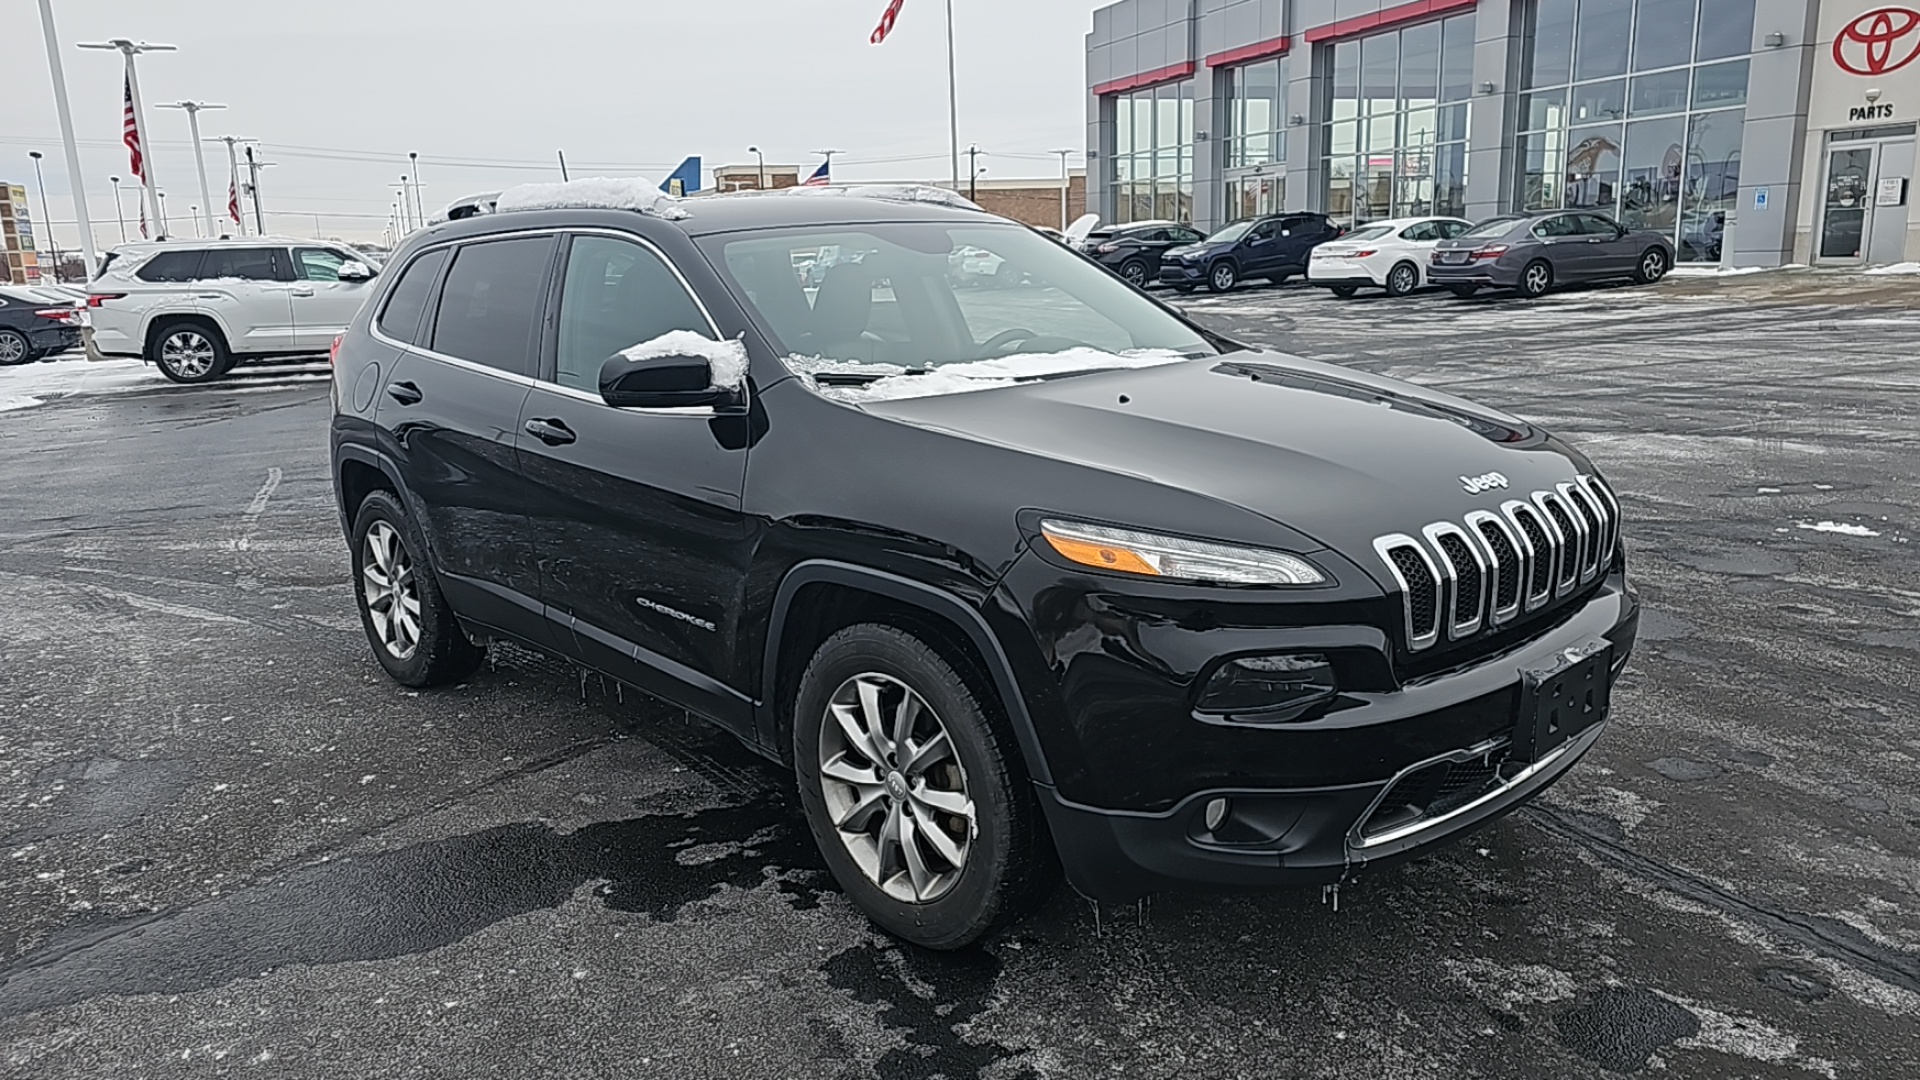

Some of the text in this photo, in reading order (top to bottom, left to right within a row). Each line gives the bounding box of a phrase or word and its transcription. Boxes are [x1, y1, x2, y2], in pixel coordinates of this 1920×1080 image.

[1849, 103, 1894, 121] PARTS
[1458, 471, 1509, 495] Jeep
[636, 597, 717, 632] CHEROKEE
